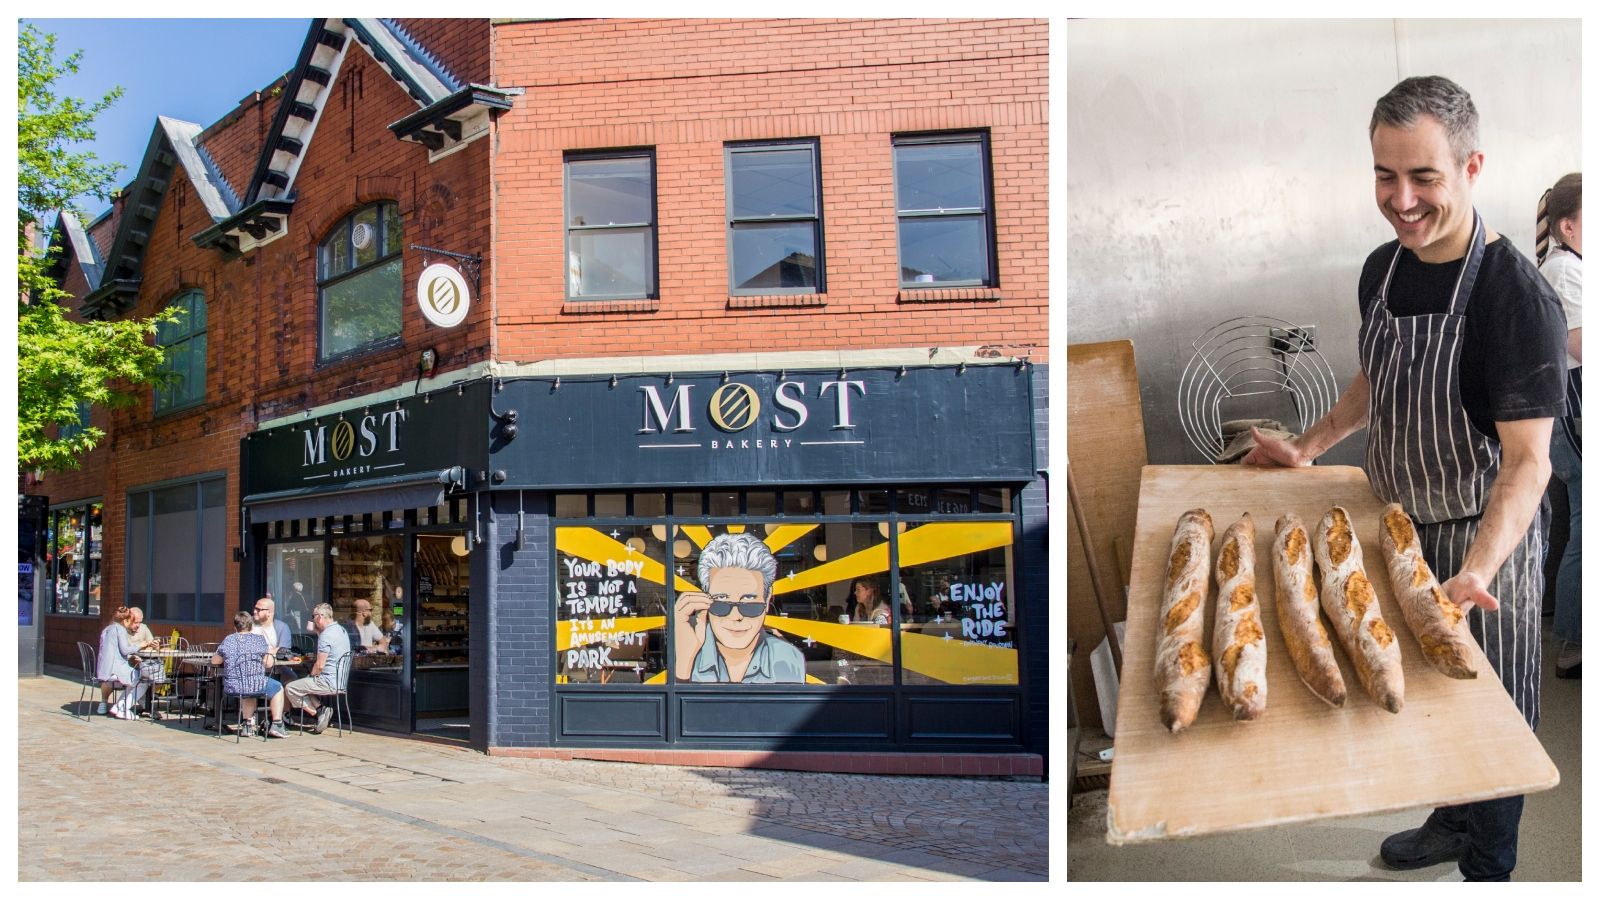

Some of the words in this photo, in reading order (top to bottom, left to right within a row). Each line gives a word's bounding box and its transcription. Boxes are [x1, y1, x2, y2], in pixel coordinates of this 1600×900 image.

[638, 380, 866, 432] MOST
[302, 409, 406, 467] MOST
[711, 439, 792, 449] BAKERY
[333, 465, 371, 477] BAKERY
[564, 558, 602, 578] YOUR
[607, 559, 644, 578] BODY
[565, 581, 587, 599] IS
[598, 580, 624, 595] NOT
[627, 580, 638, 594] A
[950, 582, 1004, 602] ENJOY
[565, 595, 628, 614] TEMPLE,
[971, 602, 1004, 619] THE
[569, 616, 594, 632] IT'S
[601, 616, 615, 629] AN
[962, 617, 1008, 639] RIDE
[570, 630, 647, 648] AMUSEMENT
